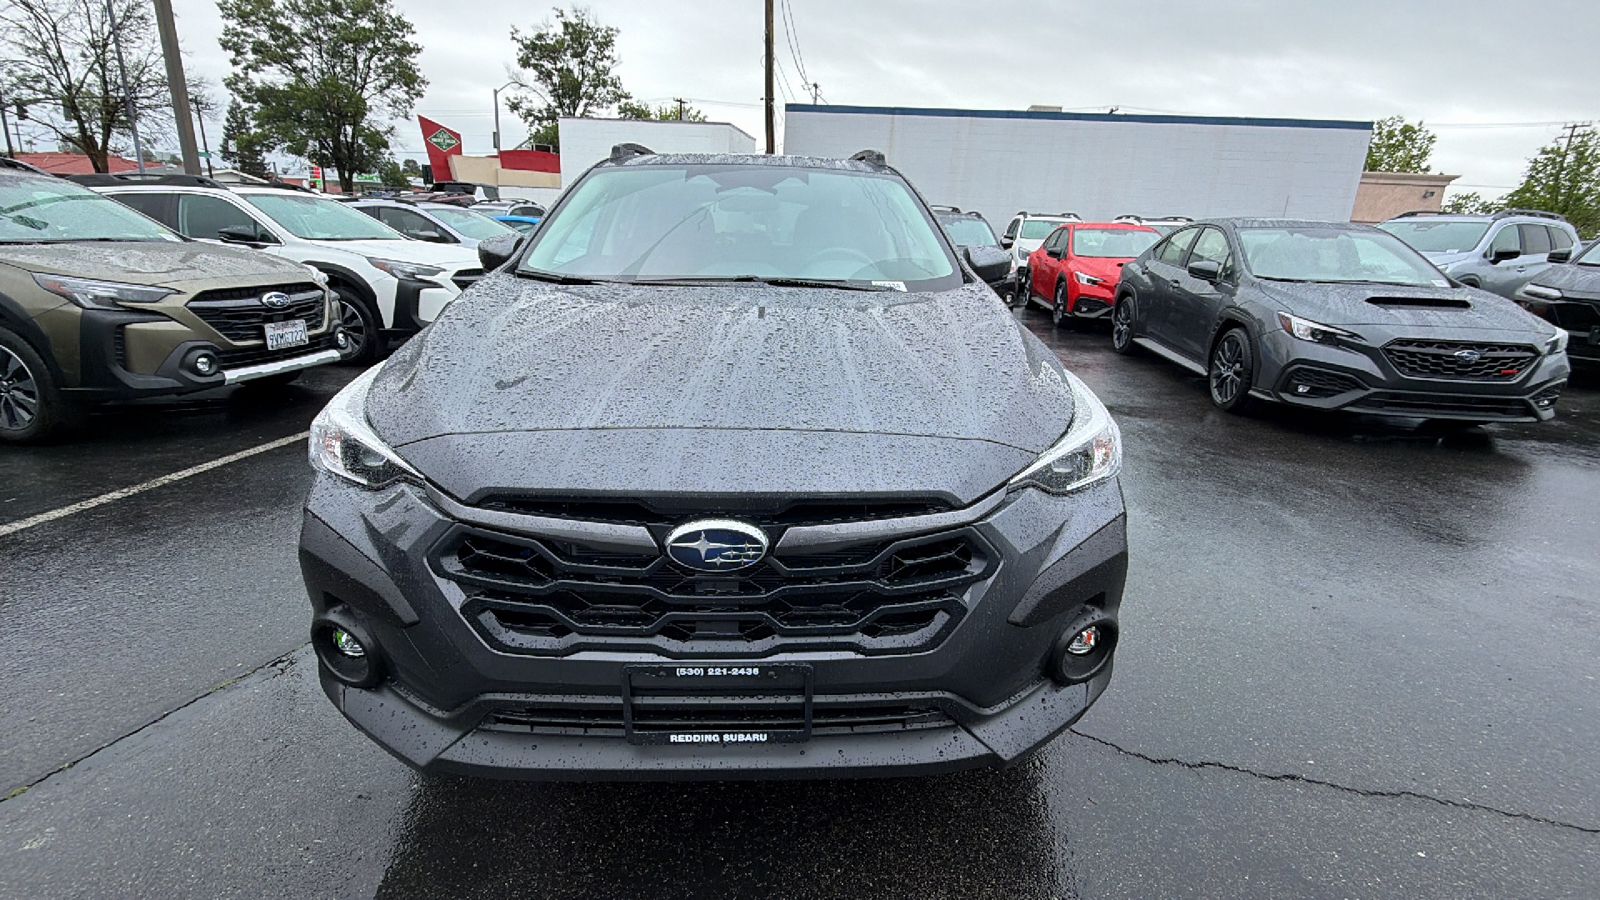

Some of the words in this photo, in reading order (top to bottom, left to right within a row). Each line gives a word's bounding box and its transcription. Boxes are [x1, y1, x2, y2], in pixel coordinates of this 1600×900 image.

[676, 667, 703, 676] (530)
[669, 734, 720, 742] REDDING
[722, 733, 767, 742] SUBARU
